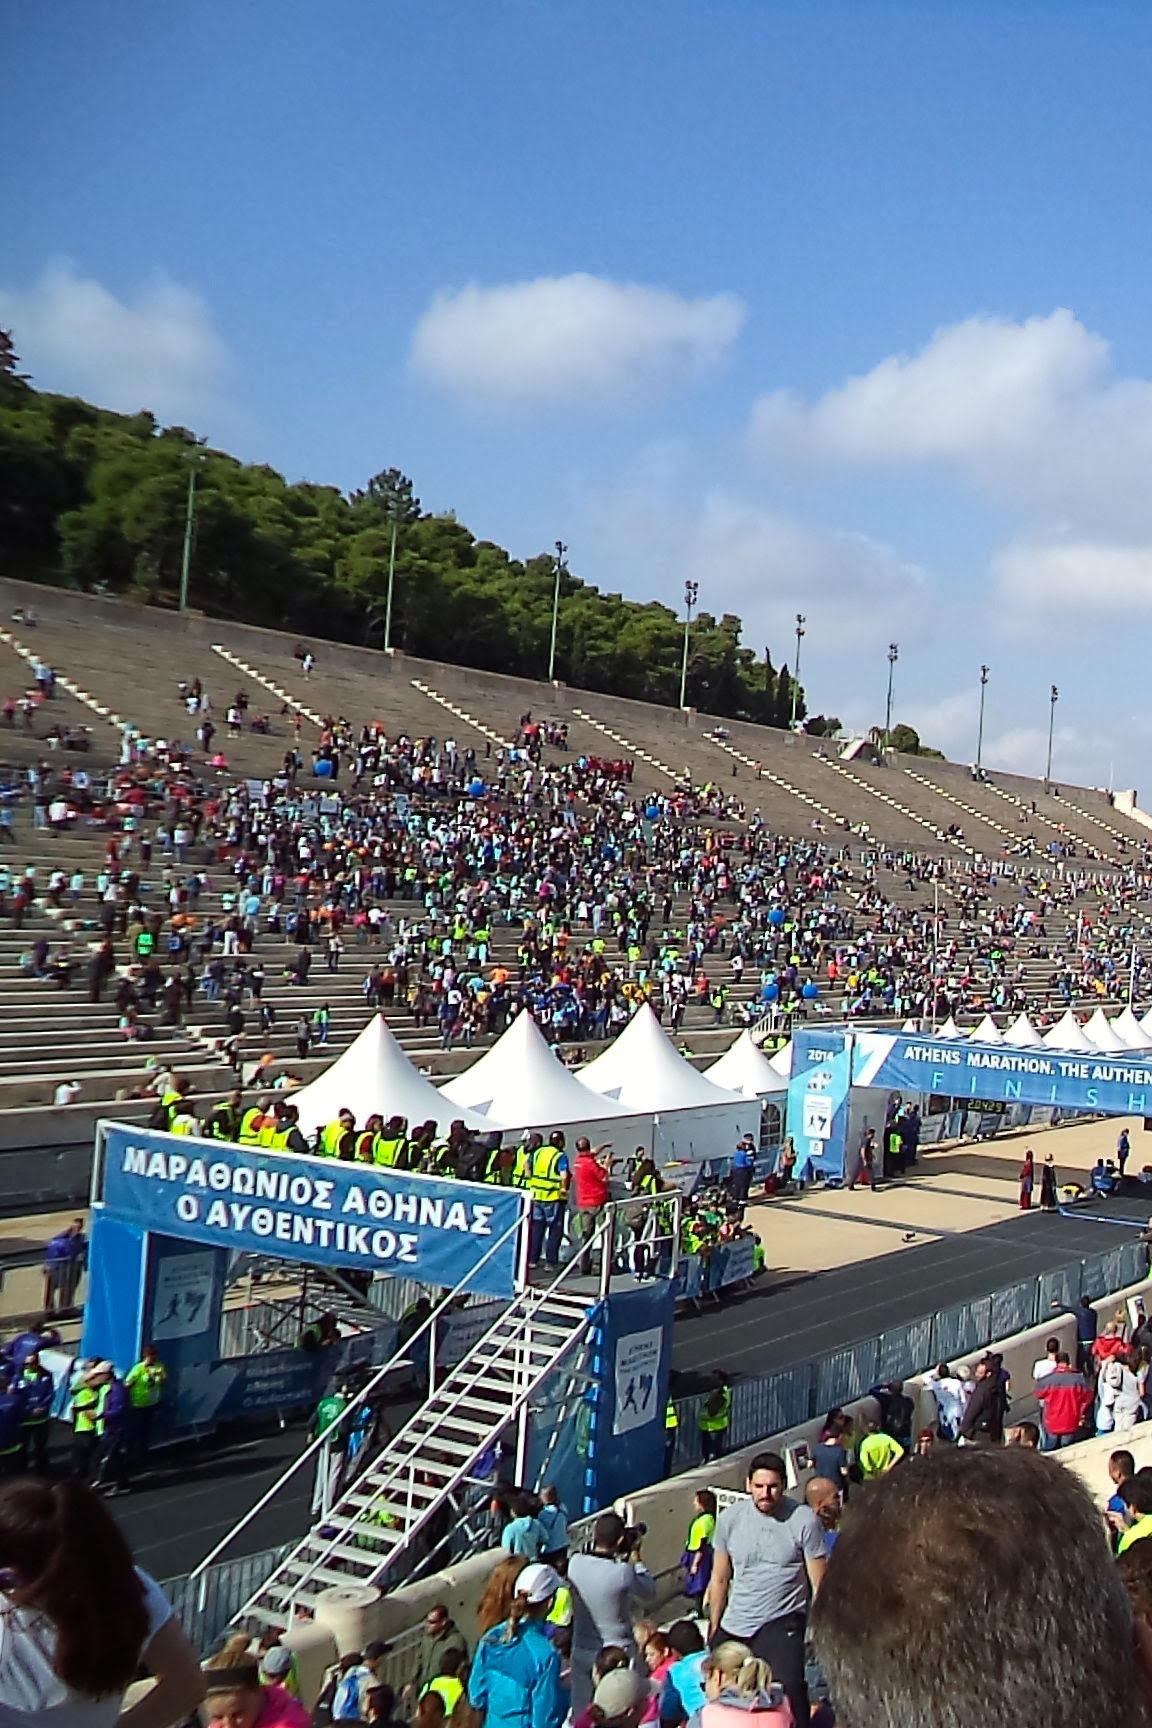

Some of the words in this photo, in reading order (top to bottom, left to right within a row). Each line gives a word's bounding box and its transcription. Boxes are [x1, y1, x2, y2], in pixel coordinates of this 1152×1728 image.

[807, 1049, 835, 1062] 2014
[904, 1046, 961, 1065] ATHENS
[967, 1052, 1056, 1075] MARATHON.
[1058, 1062, 1089, 1078] THE
[931, 1071, 1147, 1112] FINISH
[123, 1146, 335, 1210] ΜΑΡΑΘΩΝΙΟΣ
[341, 1186, 494, 1235] ΑΘΗΝΑΣ
[177, 1195, 198, 1222] Ο
[206, 1200, 419, 1263] ΑΥΘΕΝΤΙΚΟΣ
